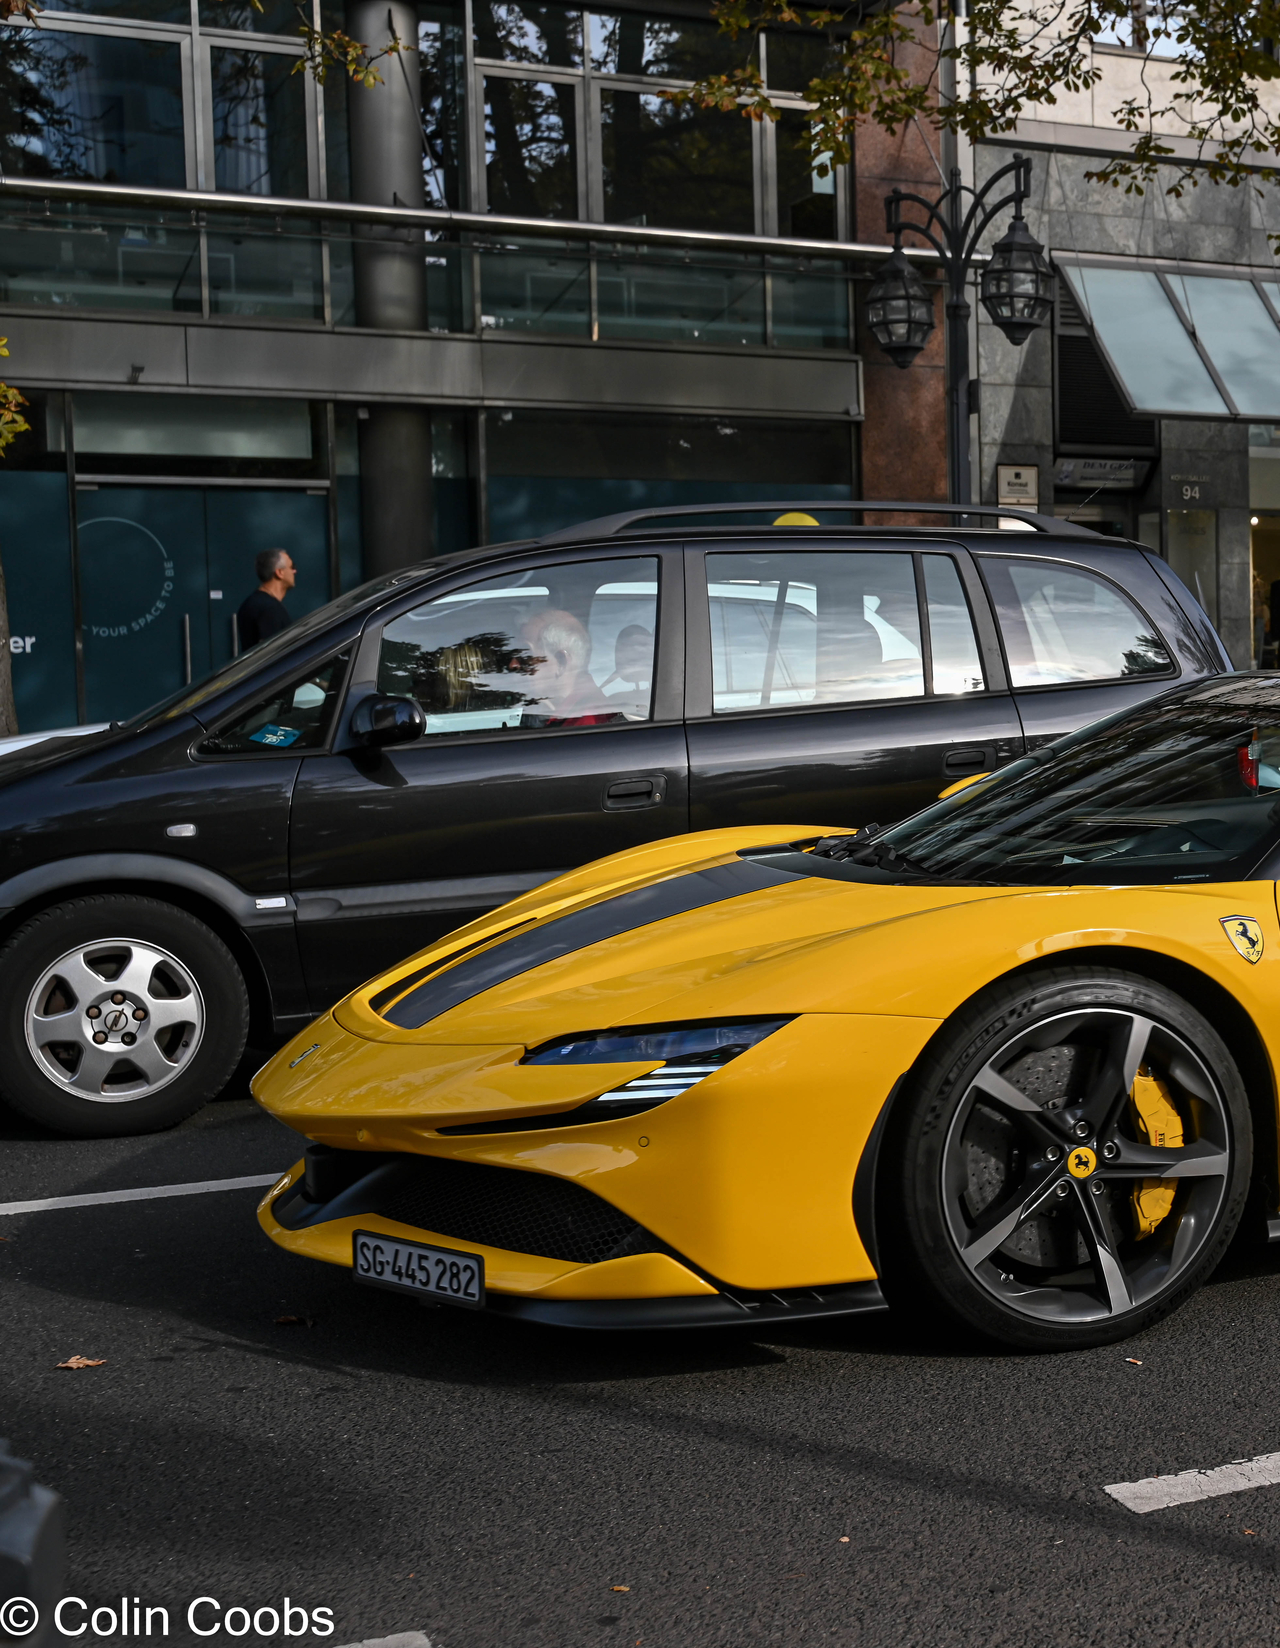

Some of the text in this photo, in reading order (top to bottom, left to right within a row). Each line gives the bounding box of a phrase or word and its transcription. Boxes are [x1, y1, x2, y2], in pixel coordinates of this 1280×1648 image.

[1182, 485, 1200, 500] 94
[92, 560, 175, 637] YOUR SPACE TO BE
[9, 636, 36, 653] er
[947, 1014, 1007, 1085] MICHELIN
